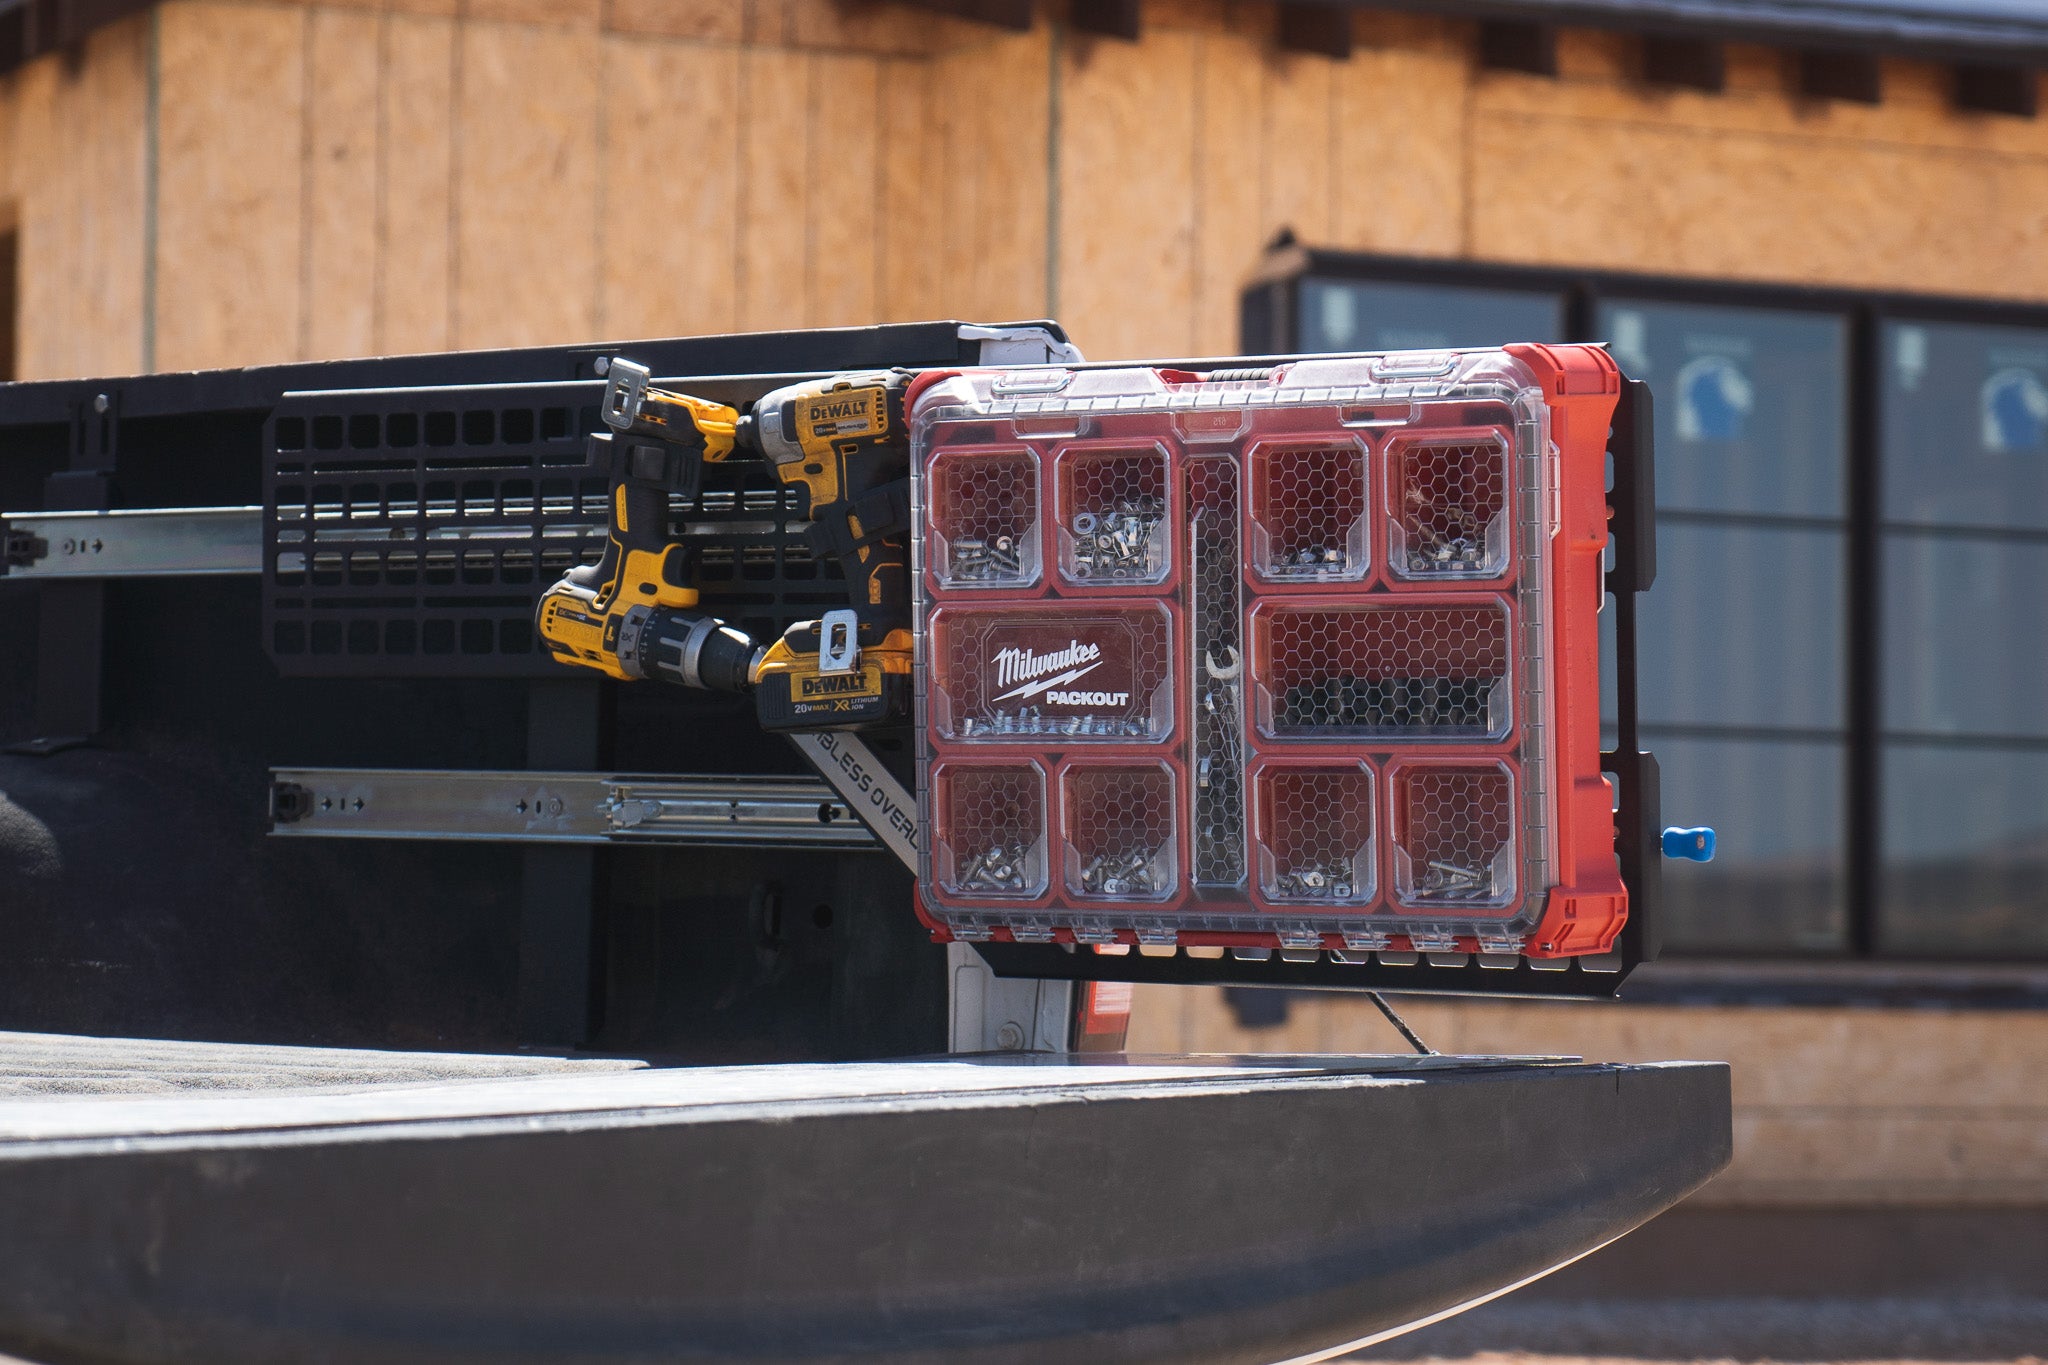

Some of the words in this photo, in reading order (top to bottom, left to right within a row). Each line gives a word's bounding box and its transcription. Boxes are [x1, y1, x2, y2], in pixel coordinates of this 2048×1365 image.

[991, 639, 1101, 689] Milwaukee
[850, 696, 879, 704] LITHIUM
[1046, 691, 1129, 706] PACKOUT
[833, 700, 852, 712] XR
[851, 703, 865, 711] ION
